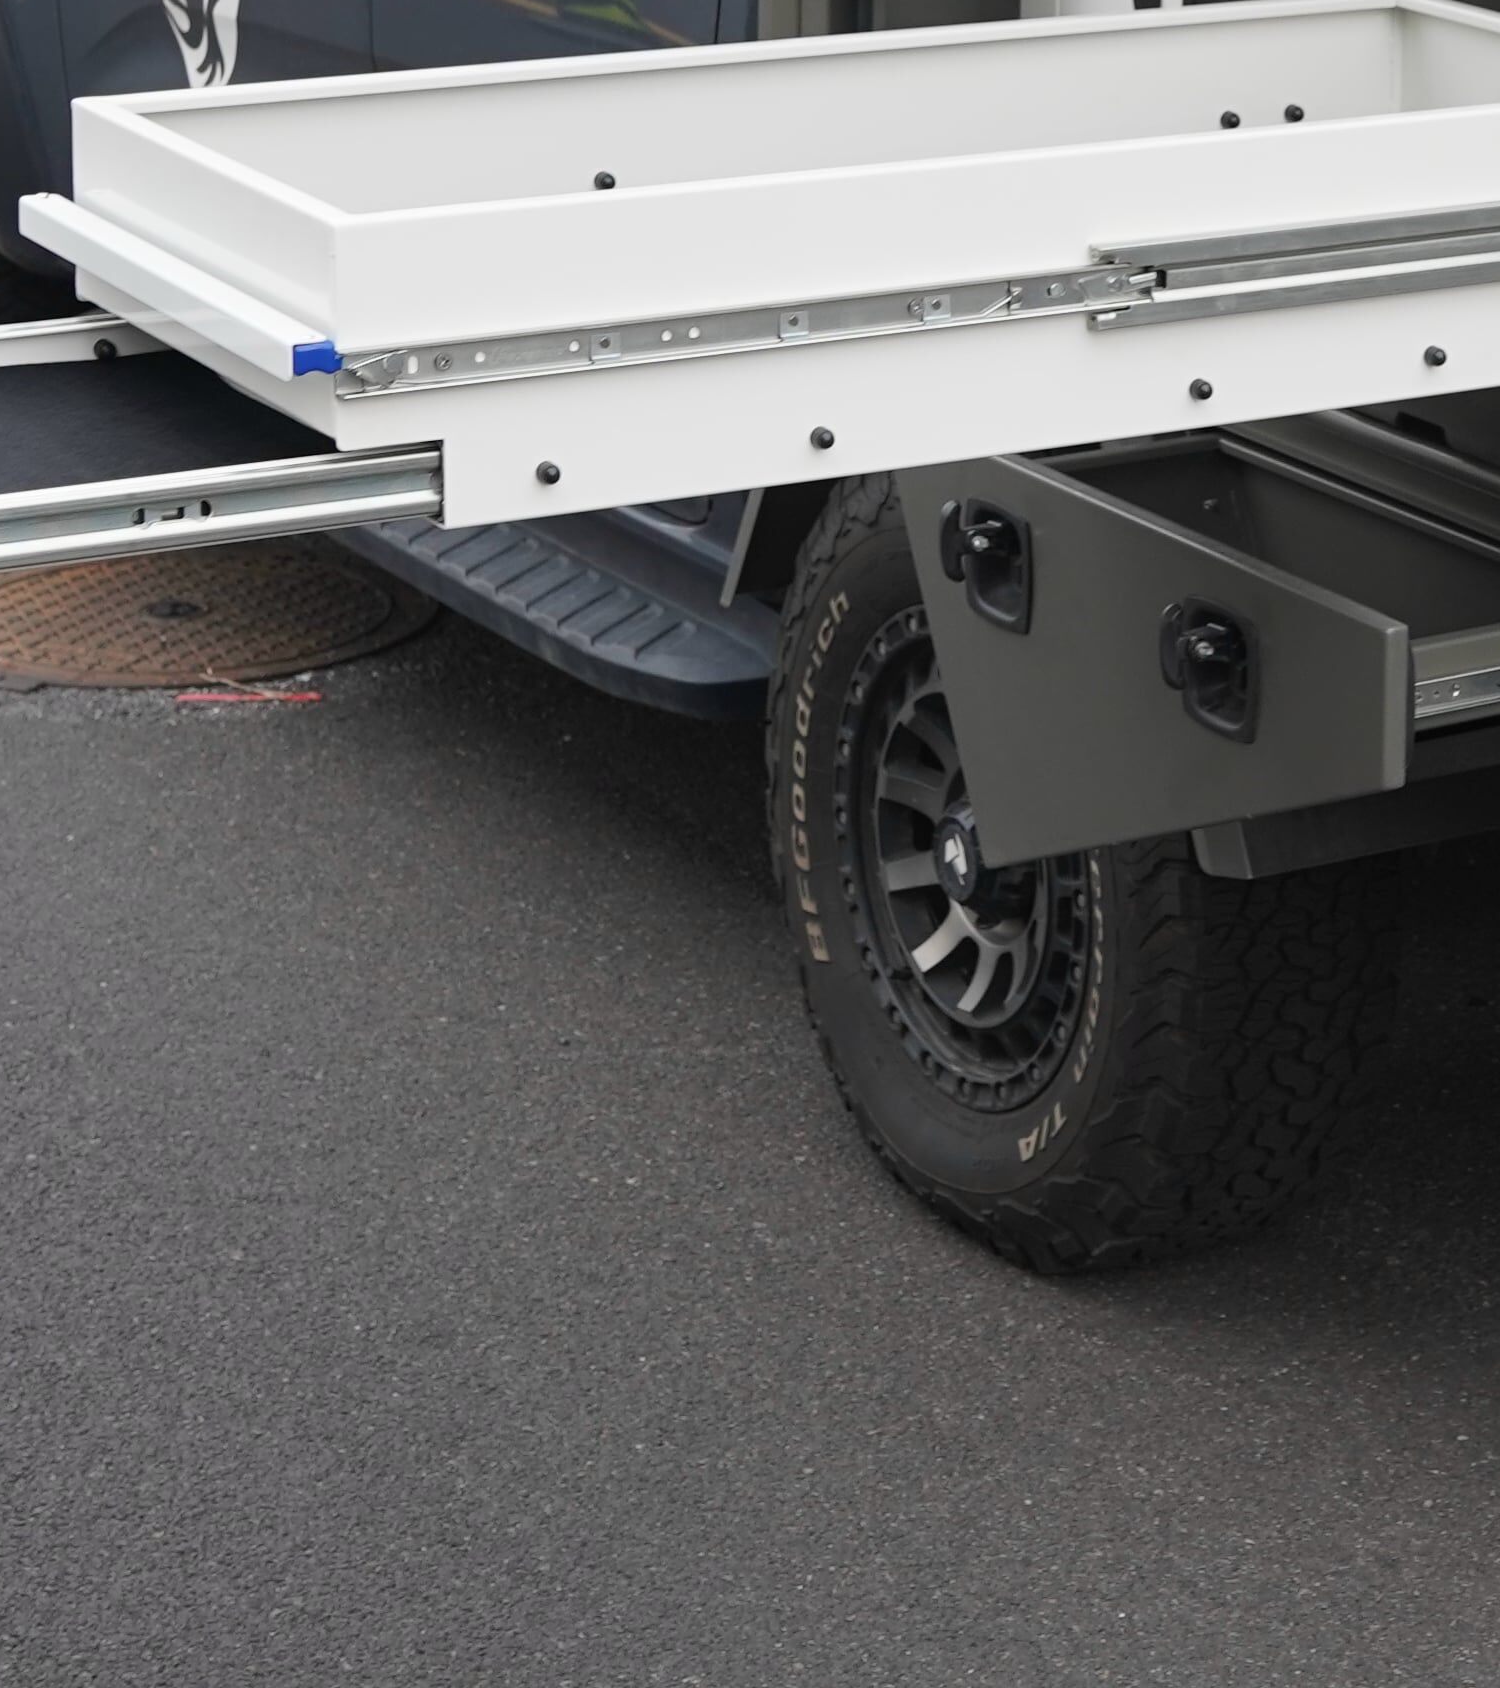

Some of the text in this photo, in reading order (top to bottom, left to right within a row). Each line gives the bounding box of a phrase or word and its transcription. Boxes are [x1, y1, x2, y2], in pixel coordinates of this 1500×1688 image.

[791, 589, 851, 963] BFGoodrich
[1017, 848, 1104, 1163] errain T/A
